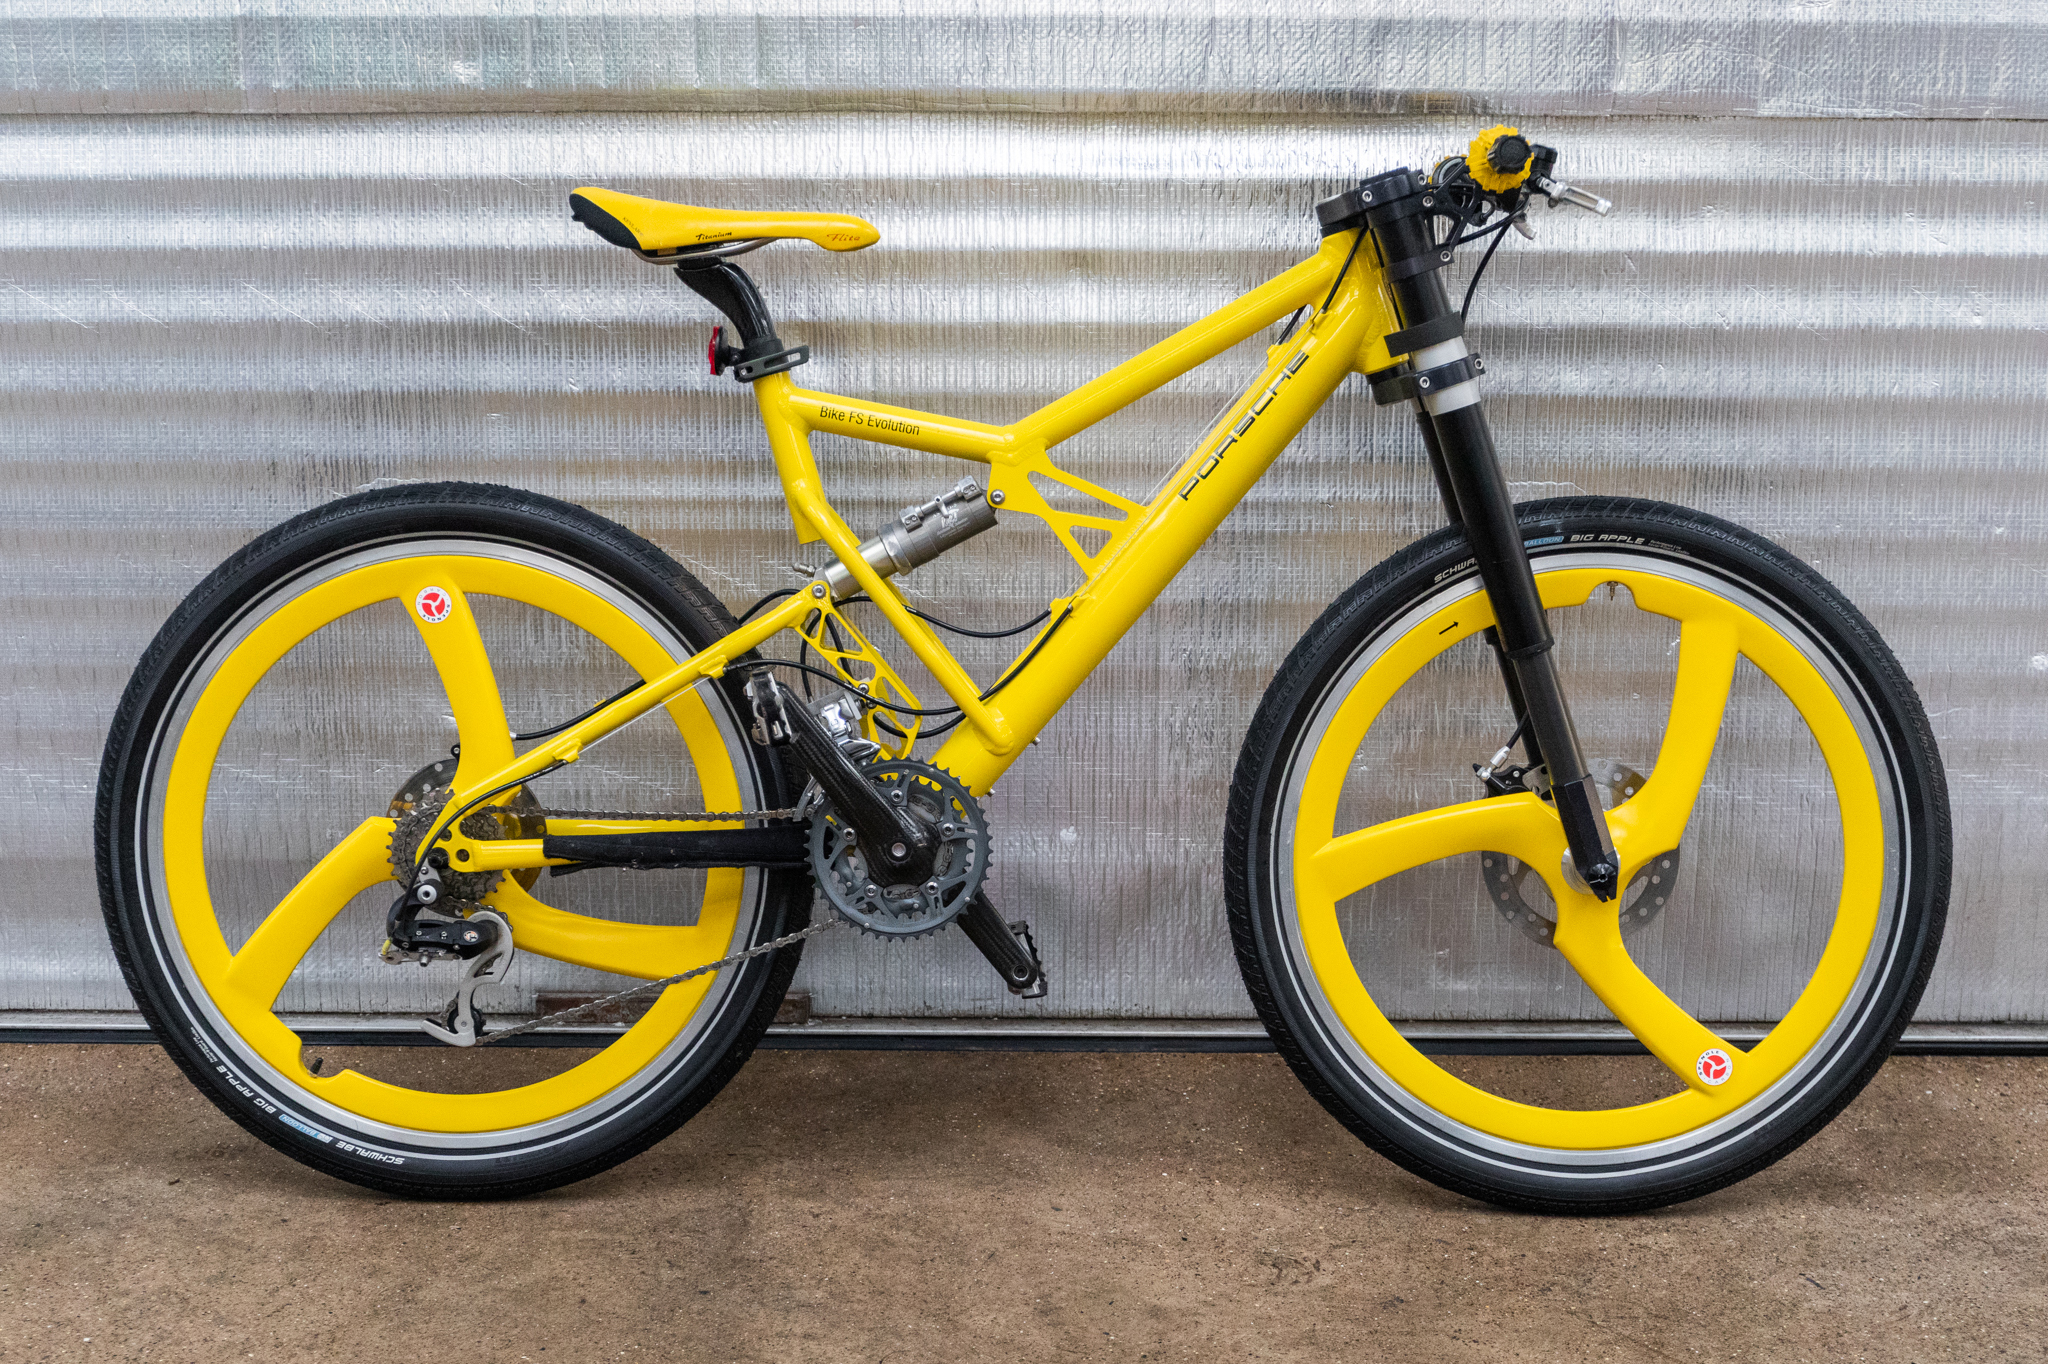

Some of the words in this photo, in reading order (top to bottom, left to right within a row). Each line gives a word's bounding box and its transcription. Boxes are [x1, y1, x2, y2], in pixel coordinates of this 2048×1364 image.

[695, 231, 732, 241] Titanium
[819, 405, 845, 422] Bike
[848, 410, 865, 425] FS
[867, 414, 920, 436] Evolution
[1177, 348, 1310, 502] PORSCHE
[1433, 557, 1477, 584] SCHWA
[1570, 534, 1595, 542] BIG
[1598, 533, 1645, 546] APPLE
[215, 1064, 255, 1099] APPLE
[253, 1097, 277, 1115] BIG
[335, 1140, 406, 1165] SCHWALBE
